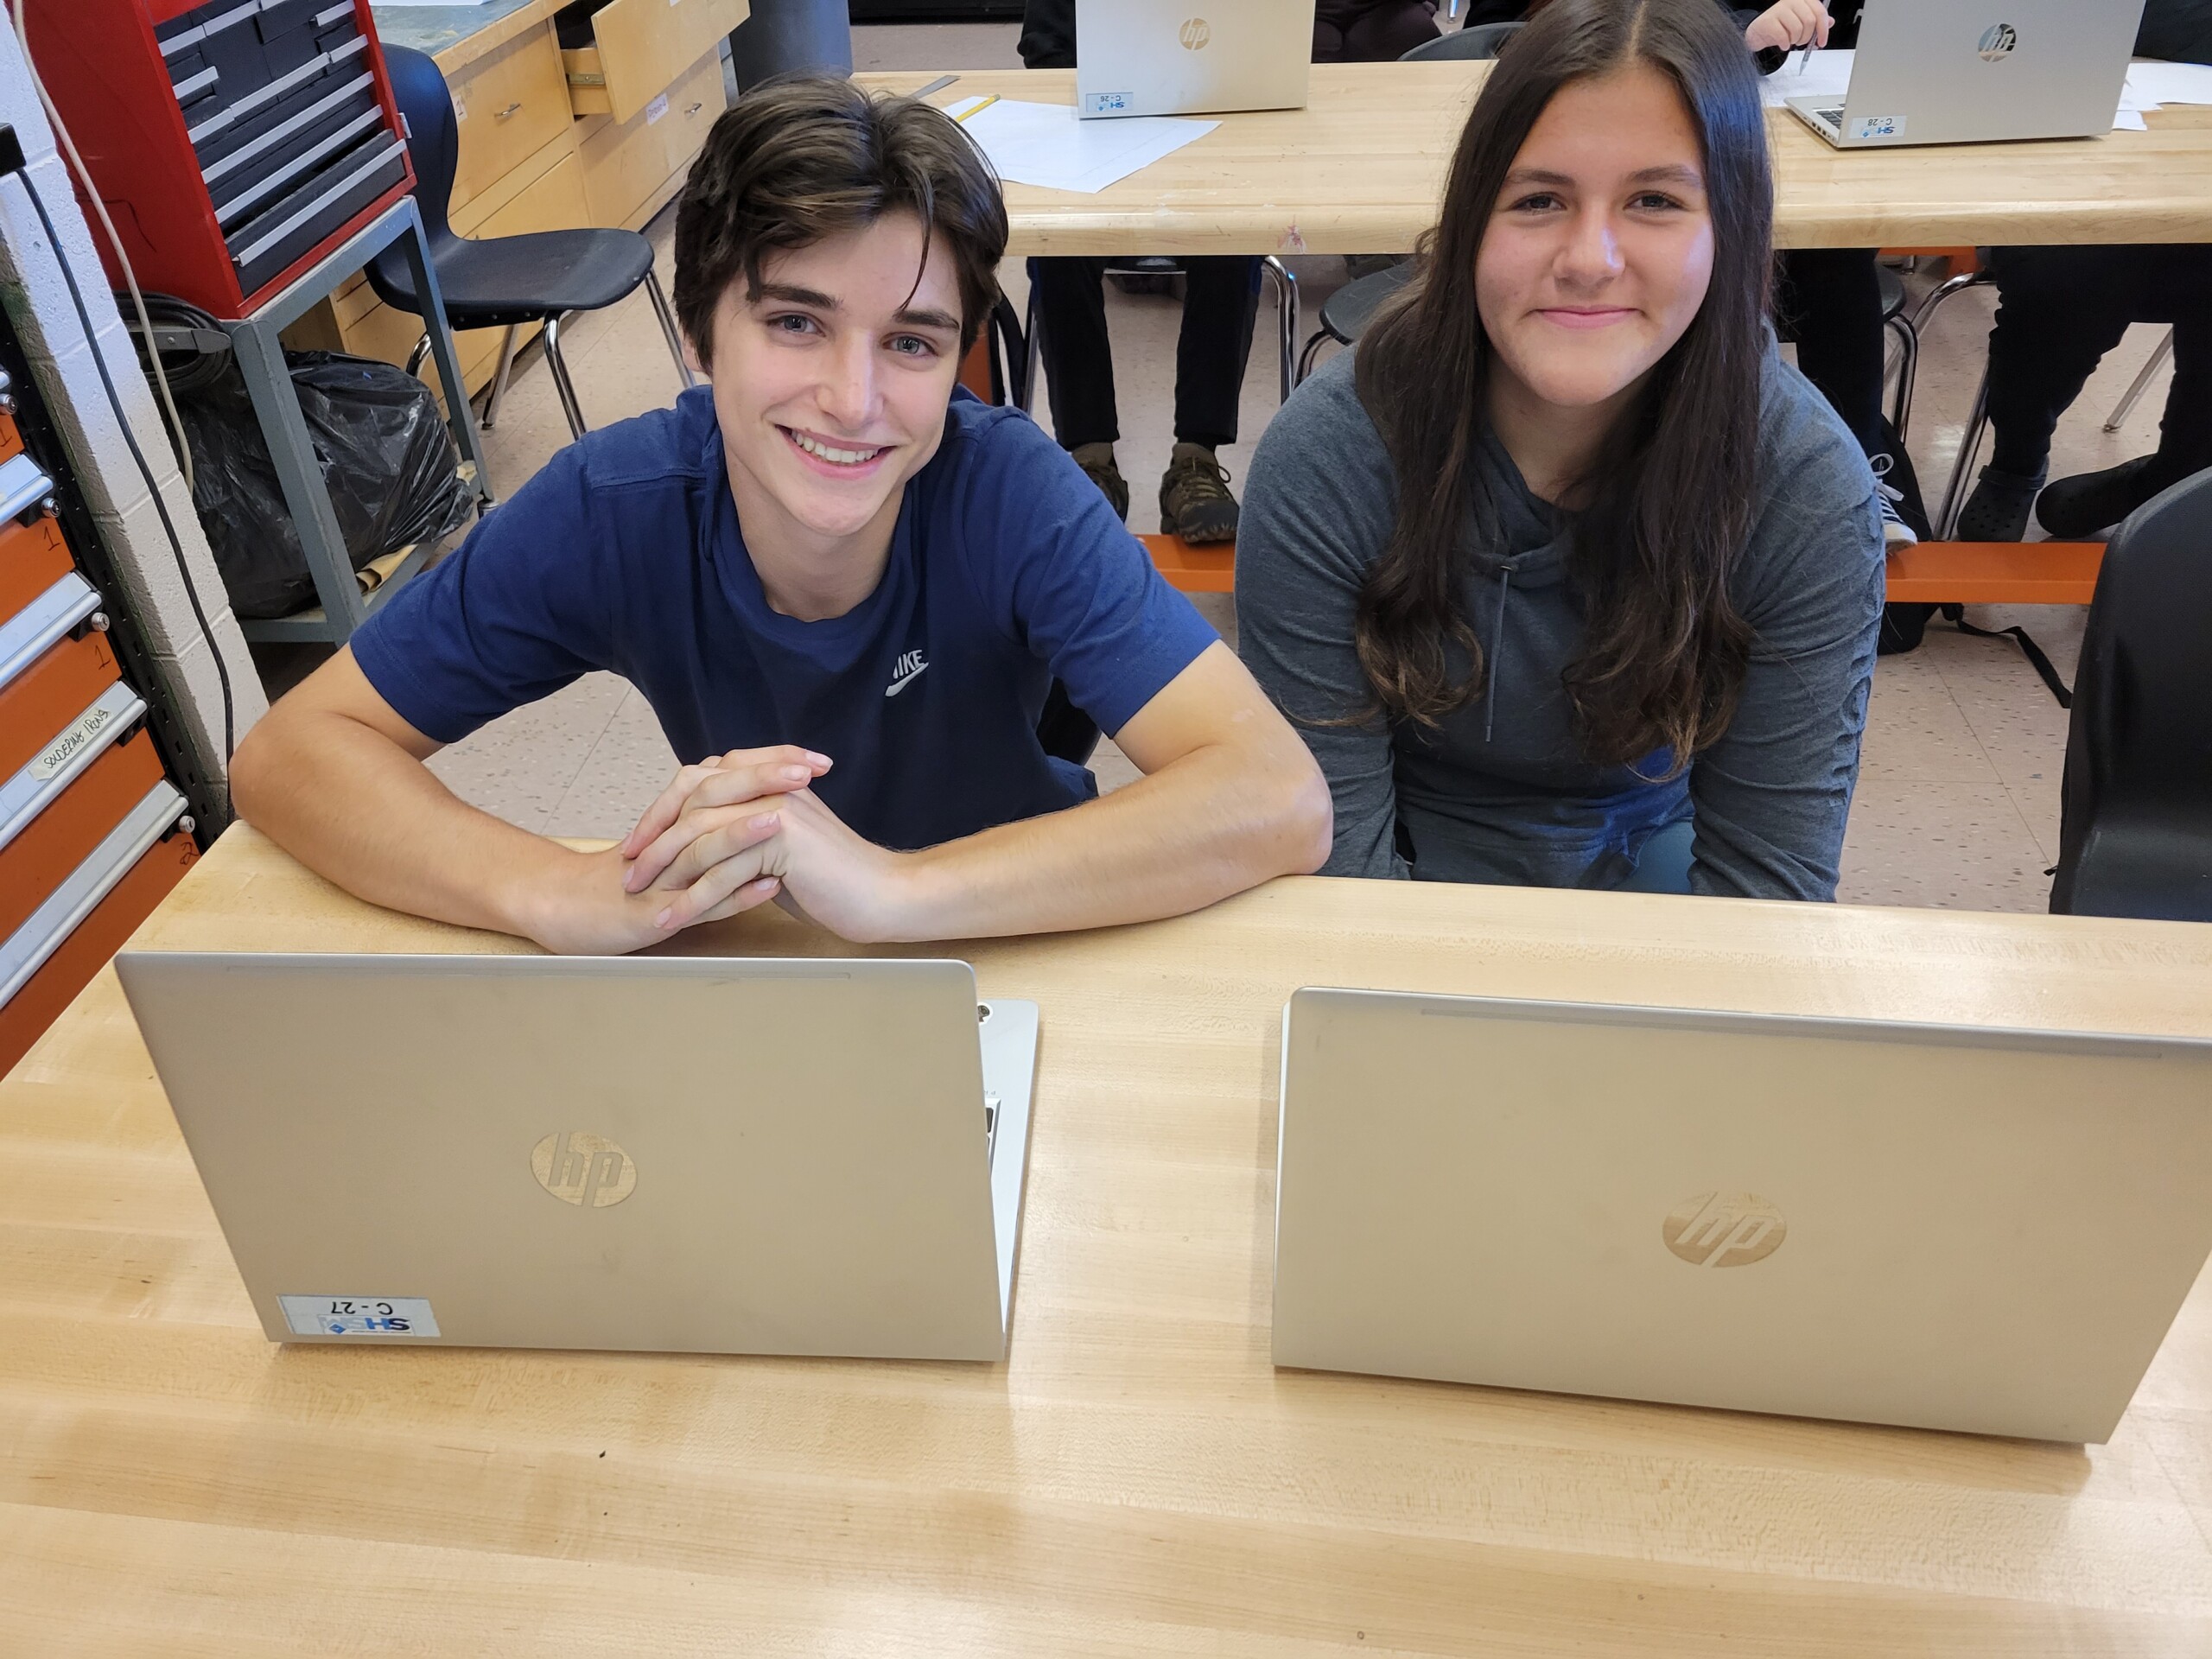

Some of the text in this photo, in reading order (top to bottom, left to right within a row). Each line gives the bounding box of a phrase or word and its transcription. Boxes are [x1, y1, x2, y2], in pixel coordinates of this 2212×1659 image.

[1181, 17, 1209, 51] hp
[1885, 118, 1892, 126] C
[43, 525, 60, 551] 1
[94, 645, 111, 671] 1
[43, 709, 109, 769] SOLDERING IRONS
[179, 841, 200, 866] 2
[547, 1133, 625, 1207] hp
[1673, 1191, 1778, 1268] hp
[330, 1301, 357, 1315] 27
[376, 1302, 394, 1316] C
